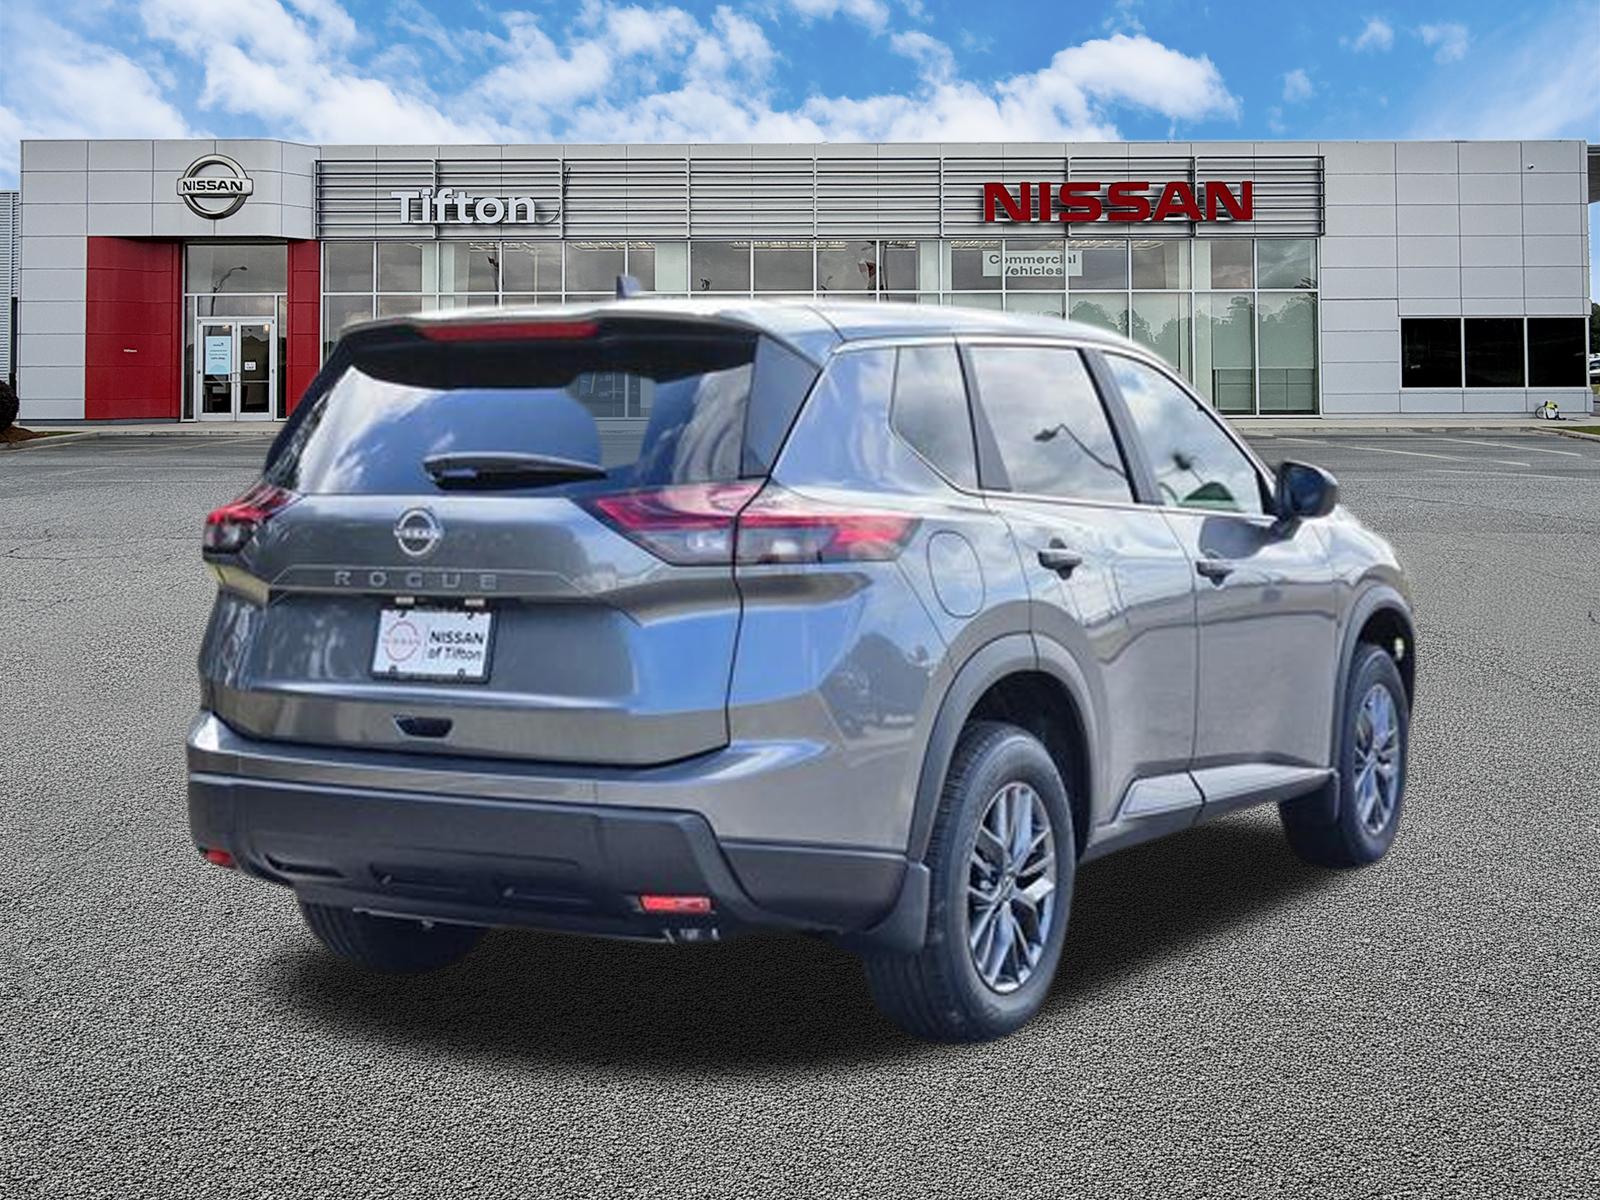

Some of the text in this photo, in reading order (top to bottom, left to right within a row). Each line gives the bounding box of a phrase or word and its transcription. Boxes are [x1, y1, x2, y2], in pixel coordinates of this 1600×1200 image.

[183, 181, 243, 191] NISSAN
[391, 188, 536, 224] Tifton
[984, 181, 1253, 223] NISSAN
[334, 571, 497, 590] ROGUE
[429, 630, 484, 645] NISSAN
